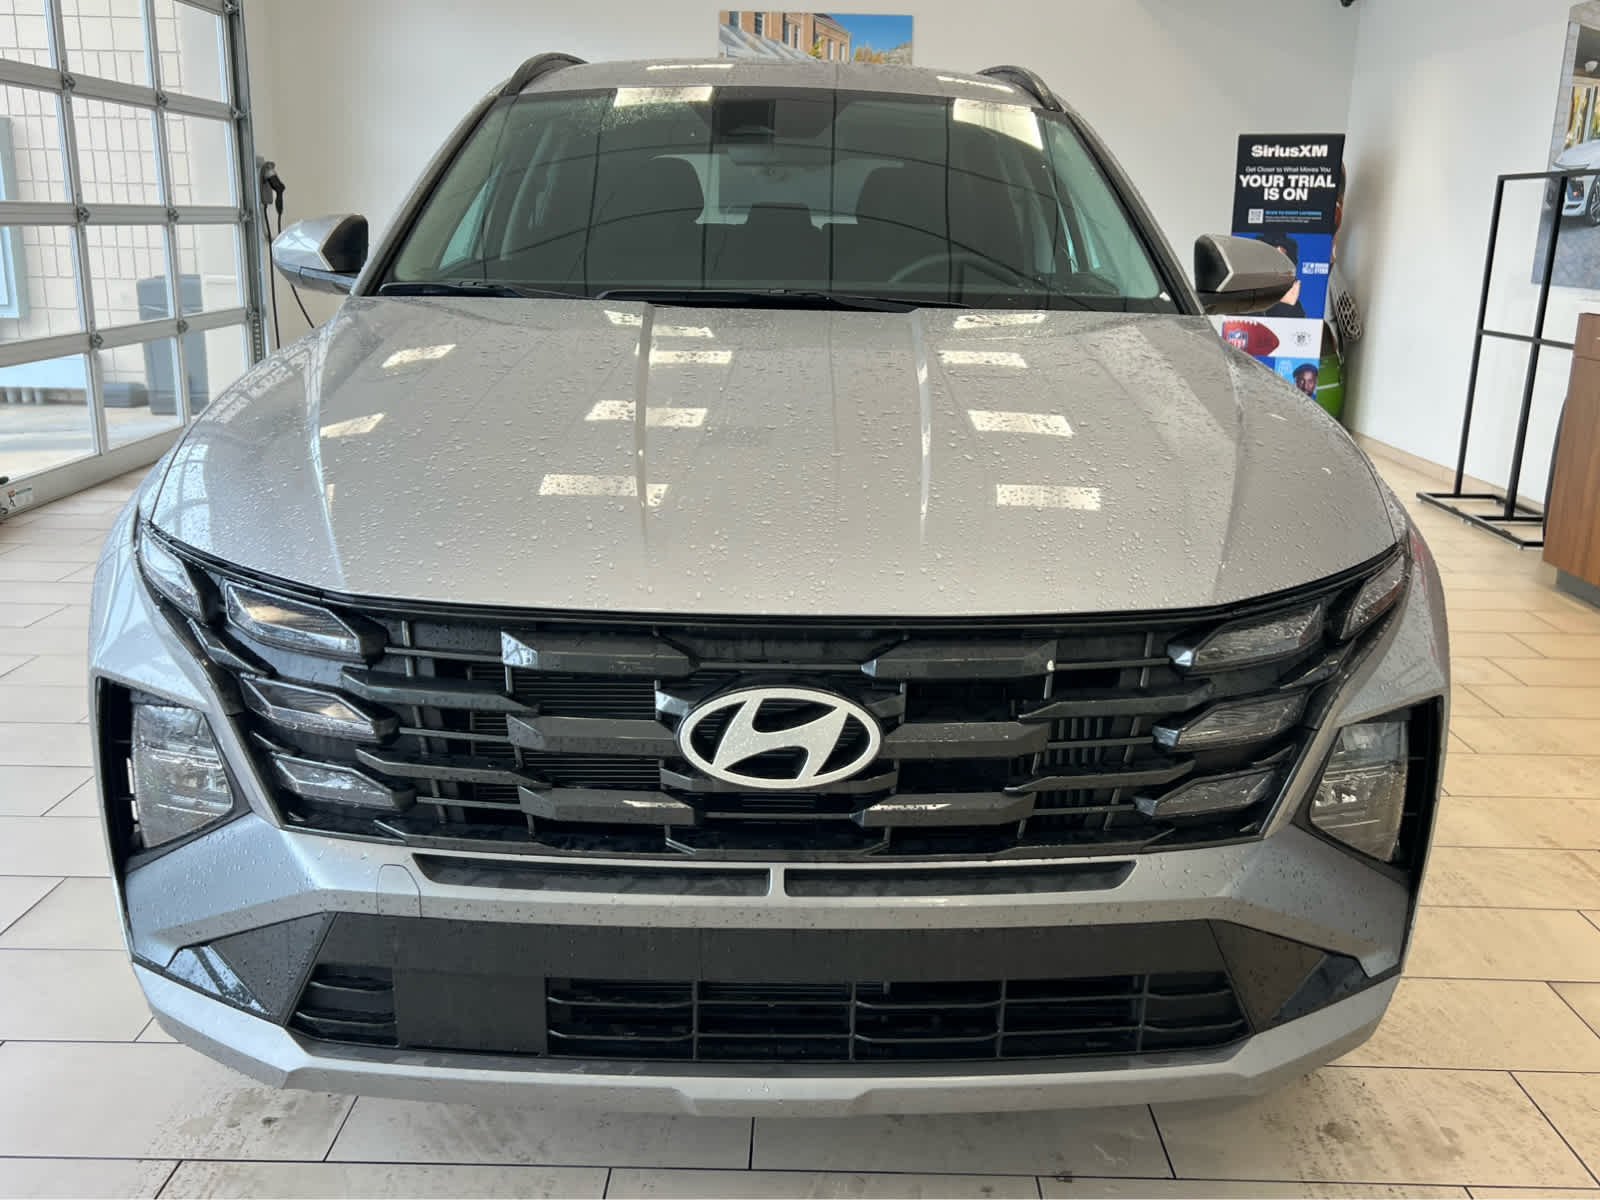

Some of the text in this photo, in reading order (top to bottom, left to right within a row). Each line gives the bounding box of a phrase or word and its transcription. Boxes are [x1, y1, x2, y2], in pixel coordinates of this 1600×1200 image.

[1251, 144, 1328, 158] SiriusXM
[1239, 175, 1336, 188] YOUR TRIAL
[1263, 188, 1308, 201] IS ON
